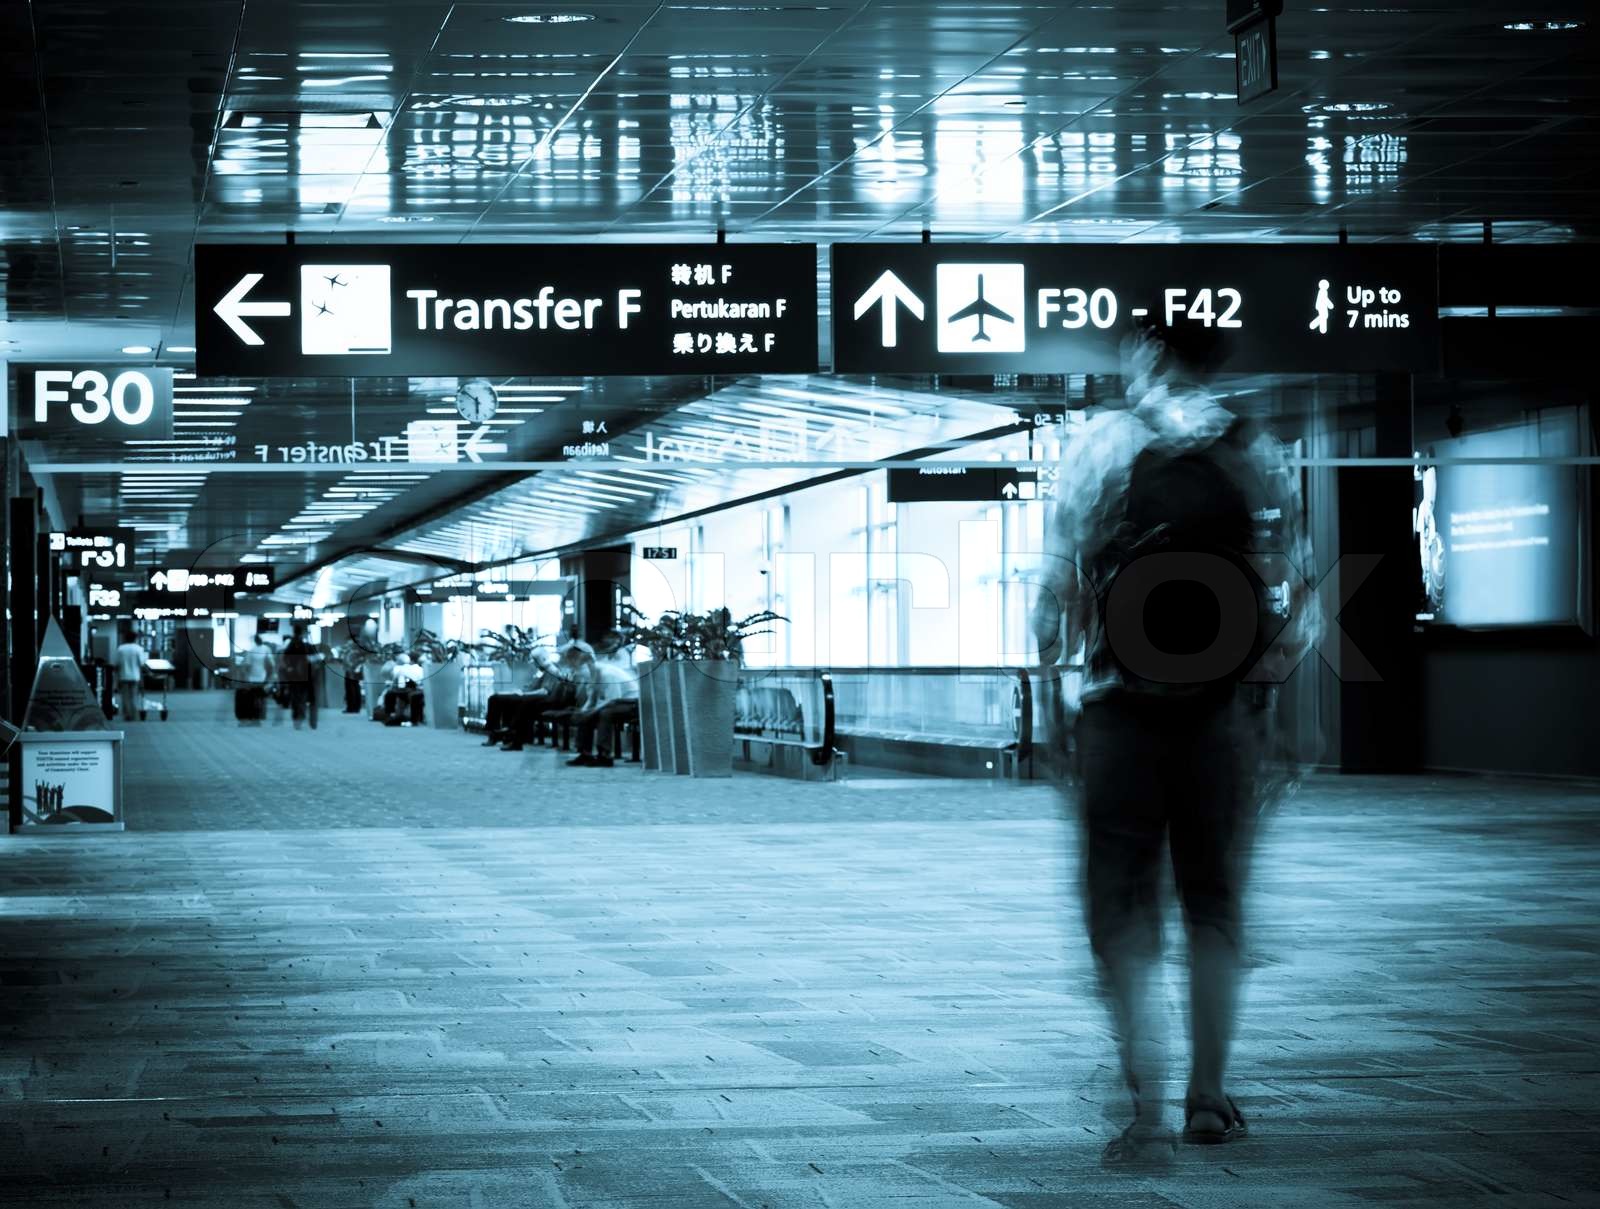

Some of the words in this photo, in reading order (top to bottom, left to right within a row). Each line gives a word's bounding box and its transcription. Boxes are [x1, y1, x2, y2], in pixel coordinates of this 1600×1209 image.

[1240, 32, 1261, 87] EXIT
[721, 264, 732, 284] F
[406, 286, 603, 331] Transfer
[618, 288, 642, 329] F
[671, 298, 771, 318] Pertukaran
[776, 298, 787, 318] F
[1037, 287, 1118, 329] F30
[1164, 287, 1243, 329] F42
[1346, 285, 1376, 308] Up
[1379, 286, 1402, 304] to
[1346, 309, 1359, 328] 7
[1364, 309, 1410, 328] mins
[764, 332, 775, 353] F
[35, 370, 154, 425] F30
[81, 542, 126, 567] F31
